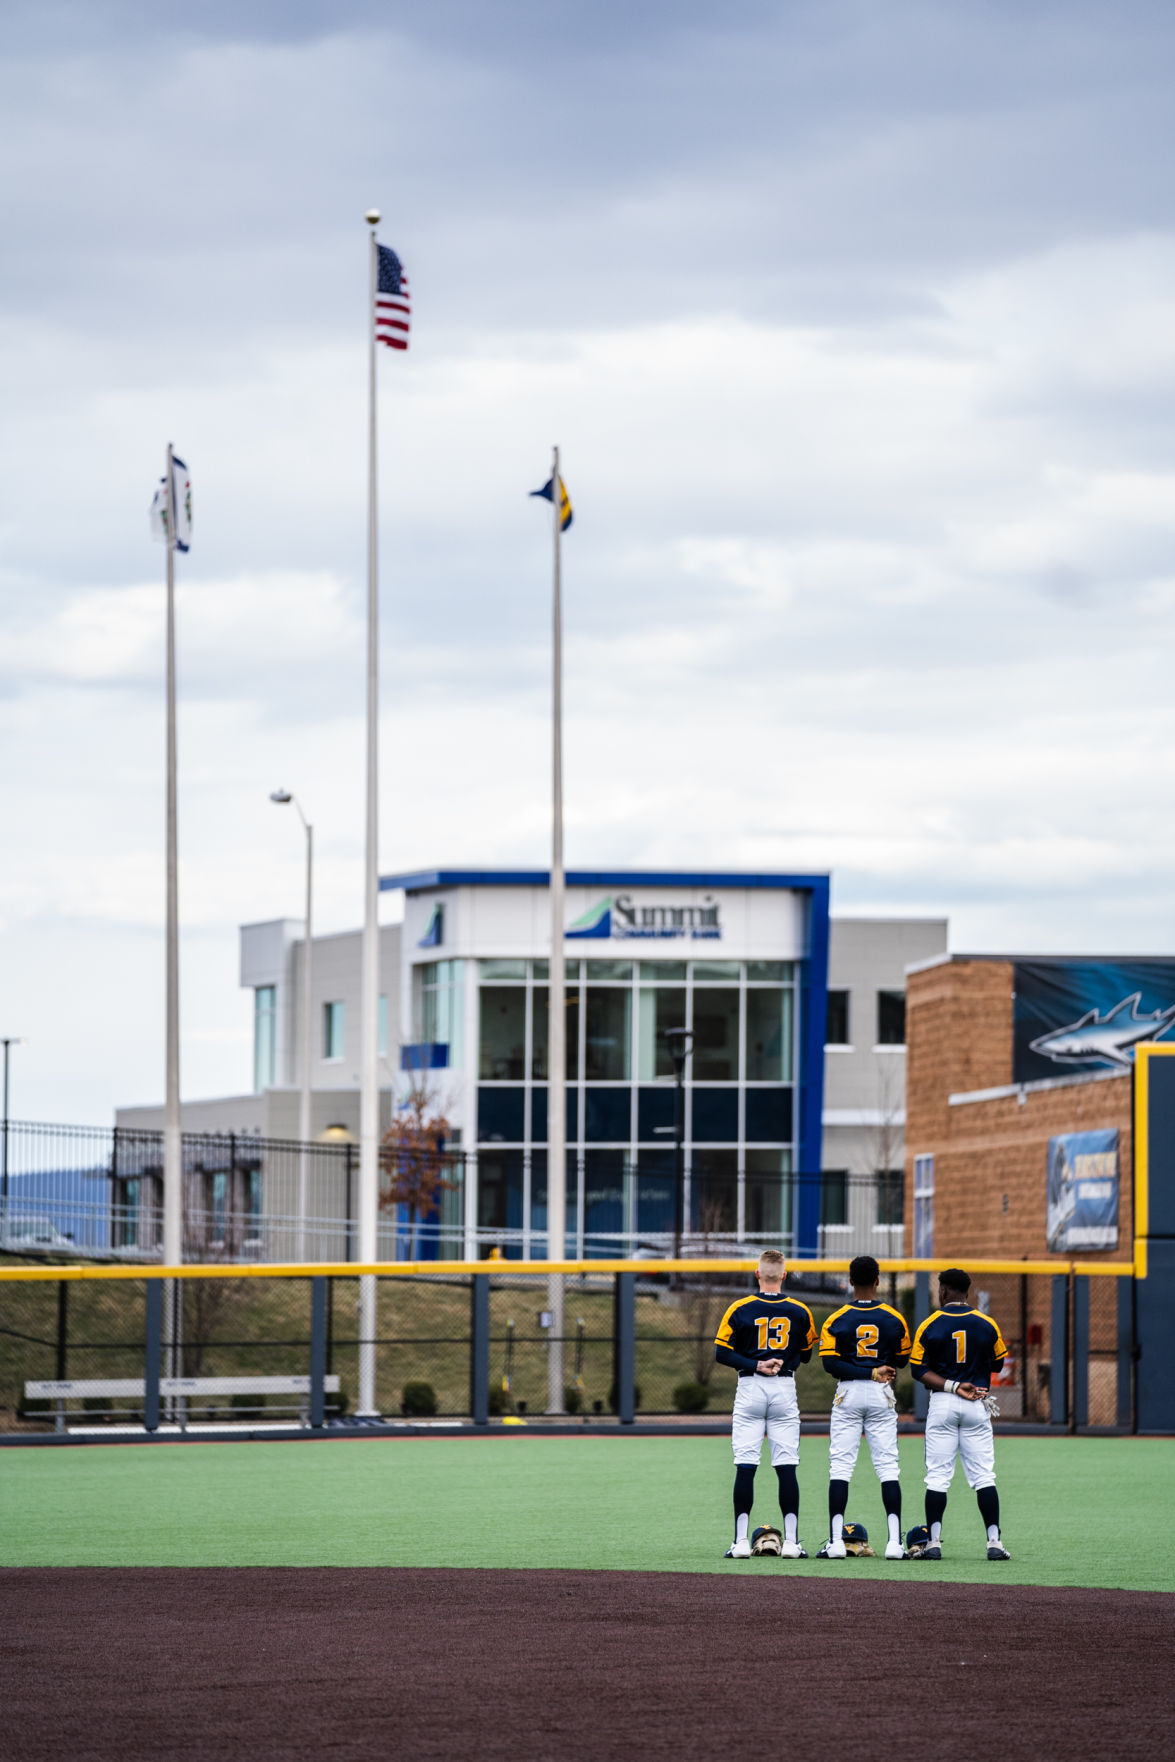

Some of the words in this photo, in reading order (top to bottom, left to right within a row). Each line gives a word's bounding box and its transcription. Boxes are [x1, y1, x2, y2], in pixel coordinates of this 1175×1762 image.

[614, 894, 720, 928] Summit
[754, 1316, 791, 1350] 13
[856, 1324, 879, 1358] 2
[951, 1330, 967, 1364] 1
